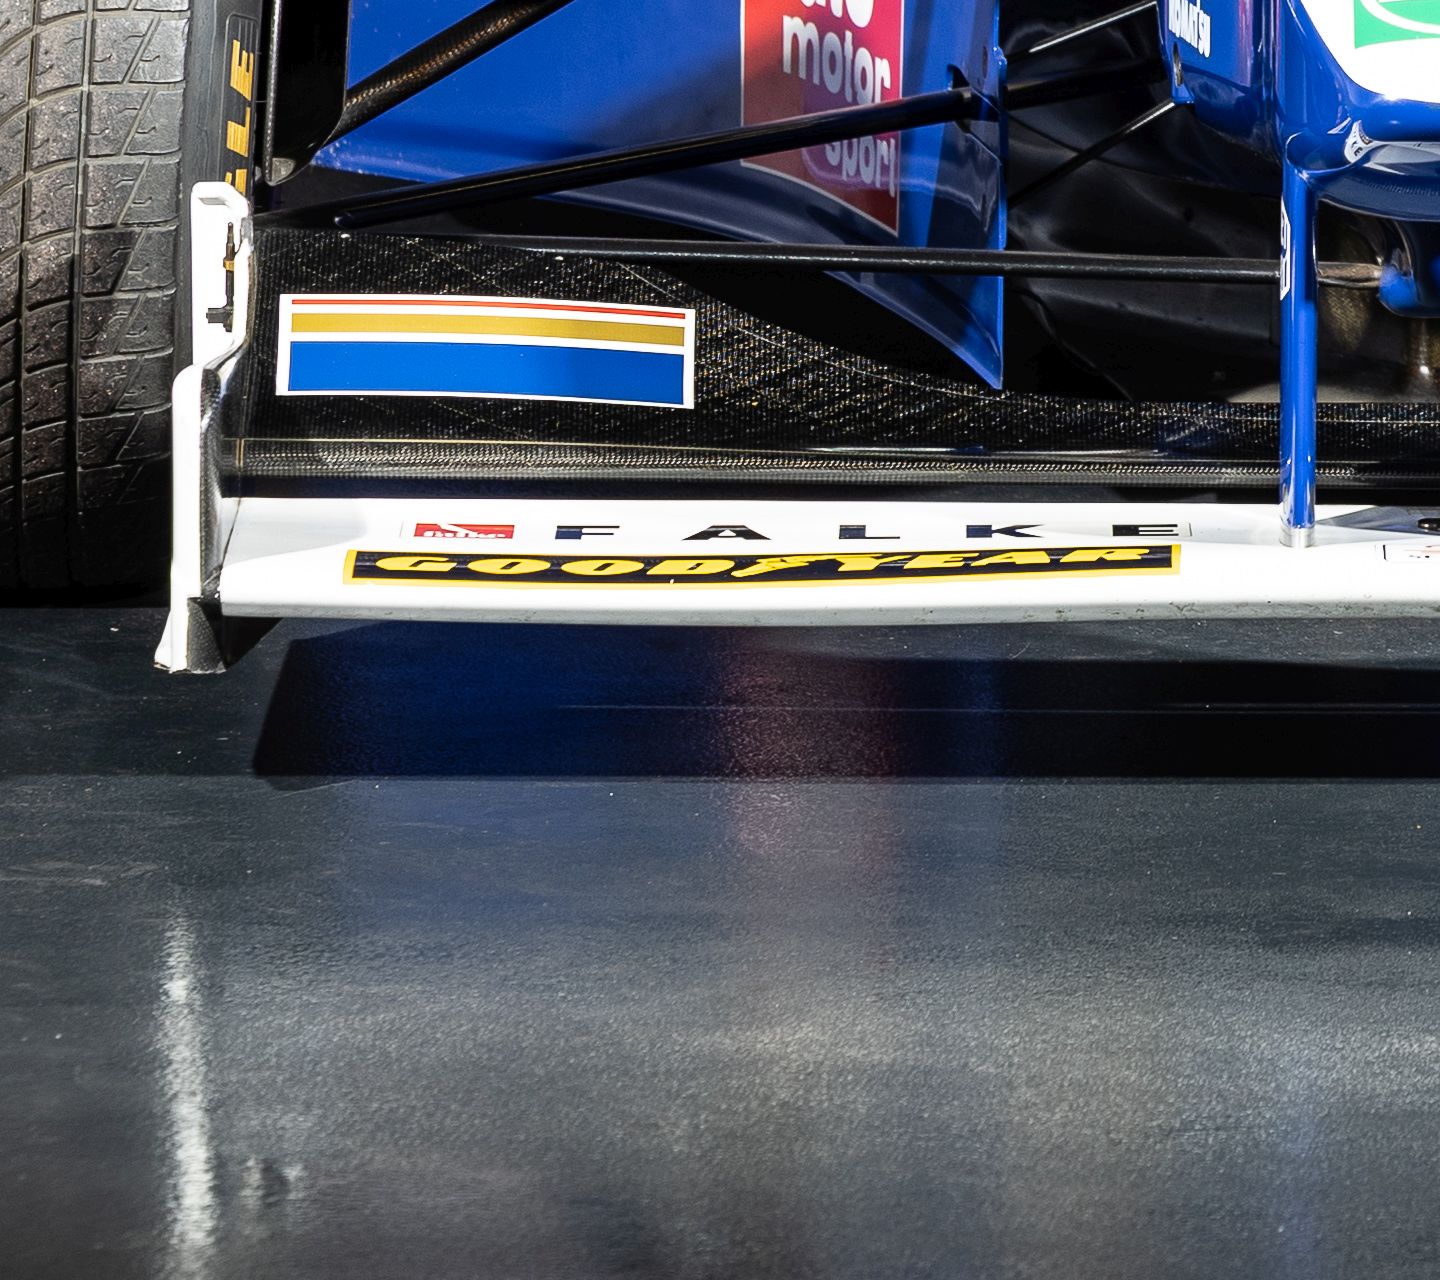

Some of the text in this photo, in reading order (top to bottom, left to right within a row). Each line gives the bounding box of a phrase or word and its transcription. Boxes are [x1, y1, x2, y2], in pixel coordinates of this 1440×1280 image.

[782, 13, 891, 104] motor
[554, 522, 1180, 541] FALKE
[375, 544, 1150, 579] GOODYEAR
